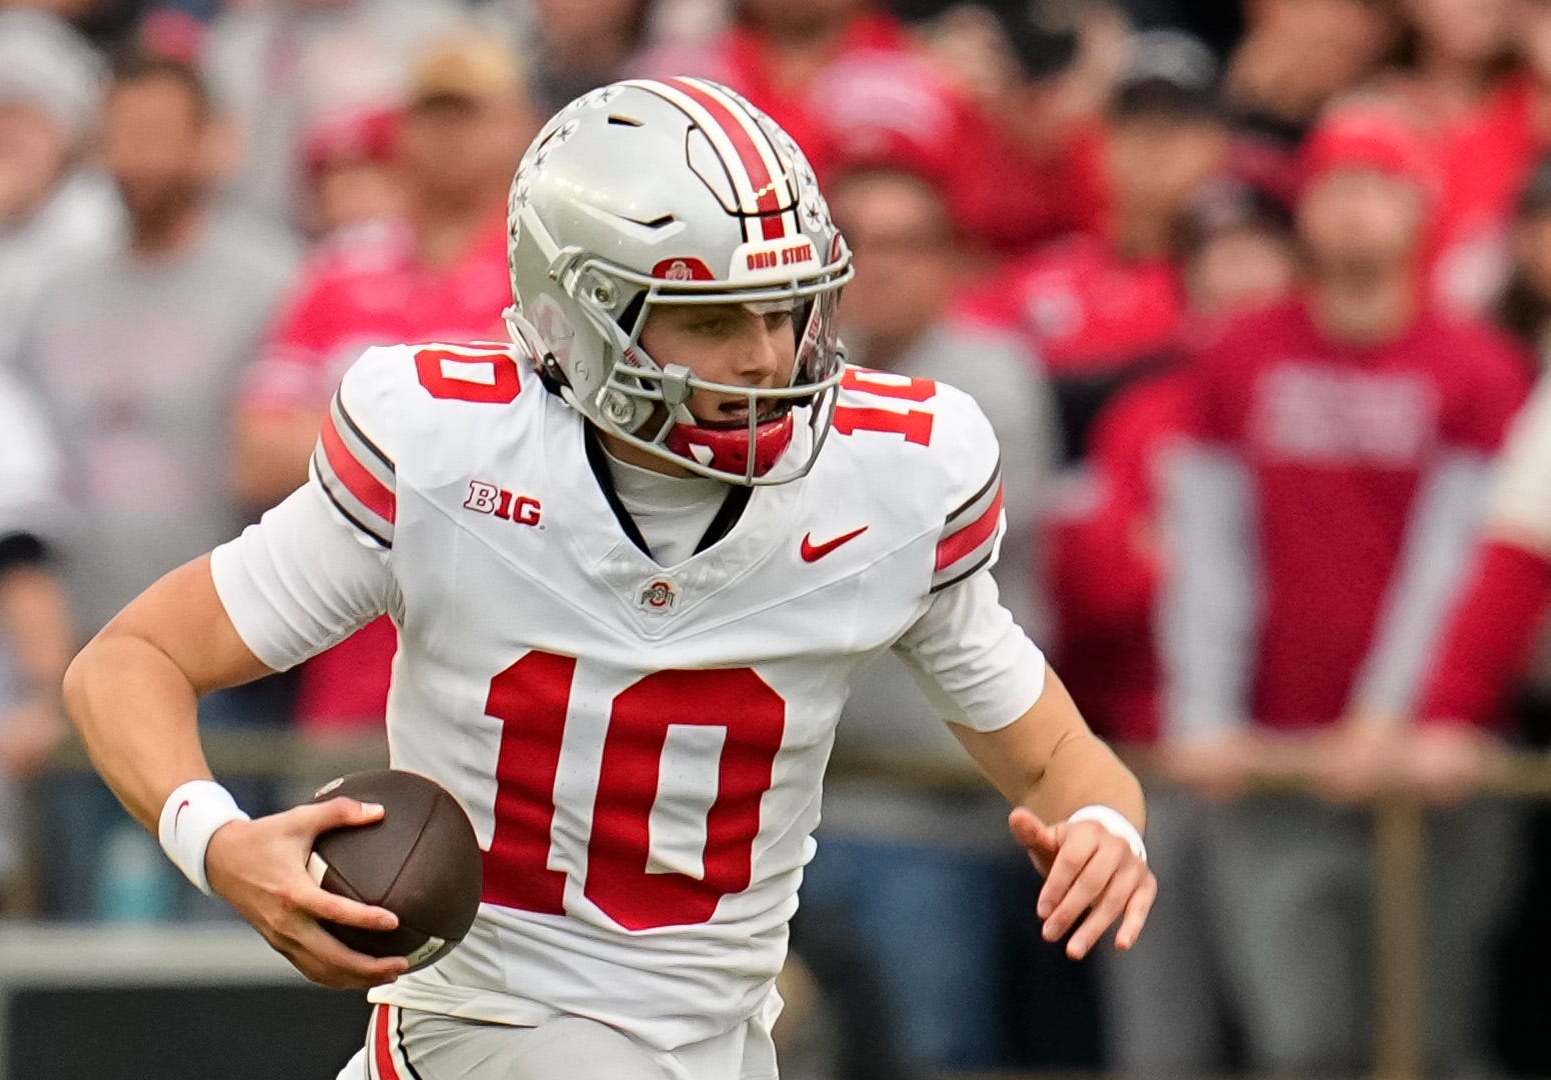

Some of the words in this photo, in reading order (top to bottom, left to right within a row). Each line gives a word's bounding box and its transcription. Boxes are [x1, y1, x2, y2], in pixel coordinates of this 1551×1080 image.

[746, 250, 777, 270] OHIO
[781, 243, 812, 265] STATE
[479, 650, 786, 931] 10
